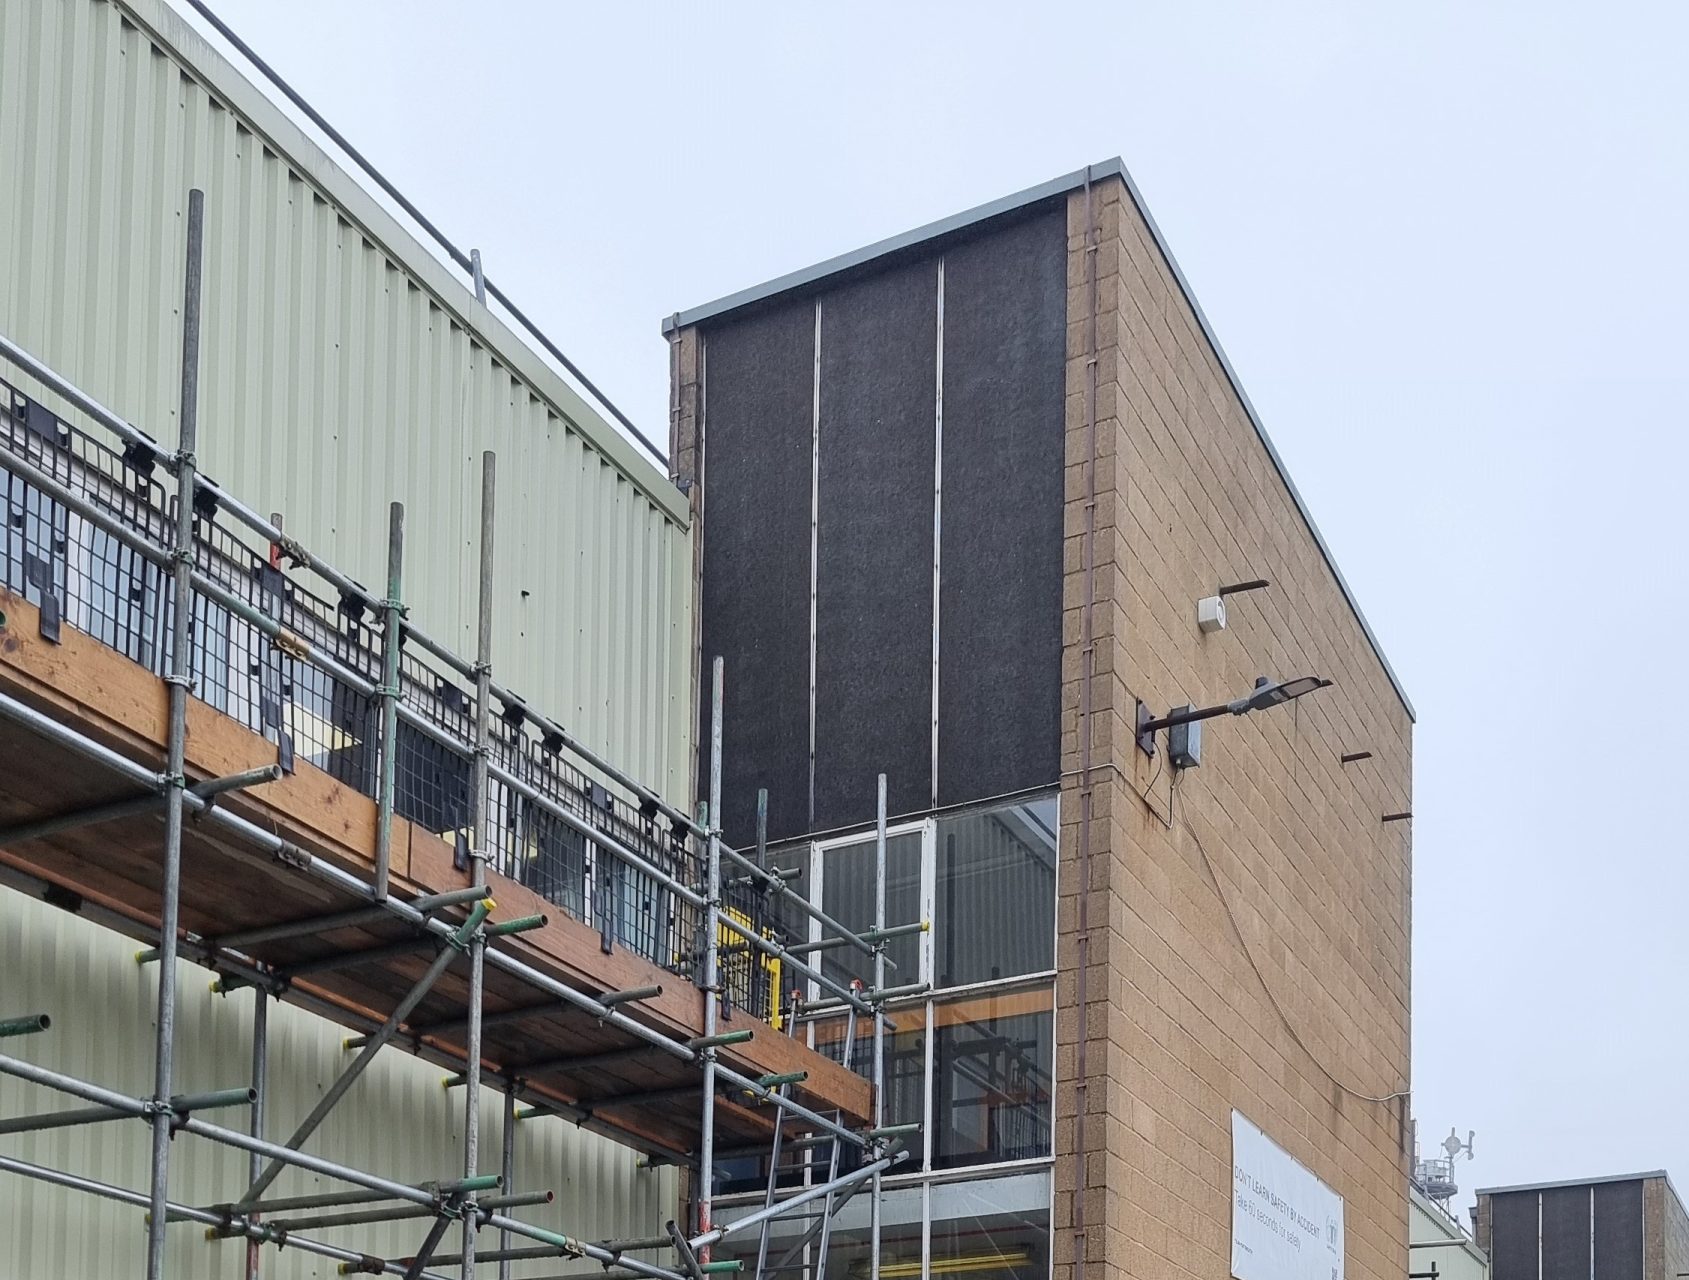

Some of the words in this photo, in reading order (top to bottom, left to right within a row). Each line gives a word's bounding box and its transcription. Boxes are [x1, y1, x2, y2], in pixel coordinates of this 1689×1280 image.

[1235, 1189, 1247, 1212] Take
[1257, 1209, 1278, 1234] seconds
[1287, 1231, 1301, 1253] safety
[1253, 1179, 1269, 1203] LEARN
[1271, 1193, 1289, 1217] SAFETY
[1290, 1208, 1297, 1223] BY
[1297, 1214, 1320, 1239] ACCIDENT
